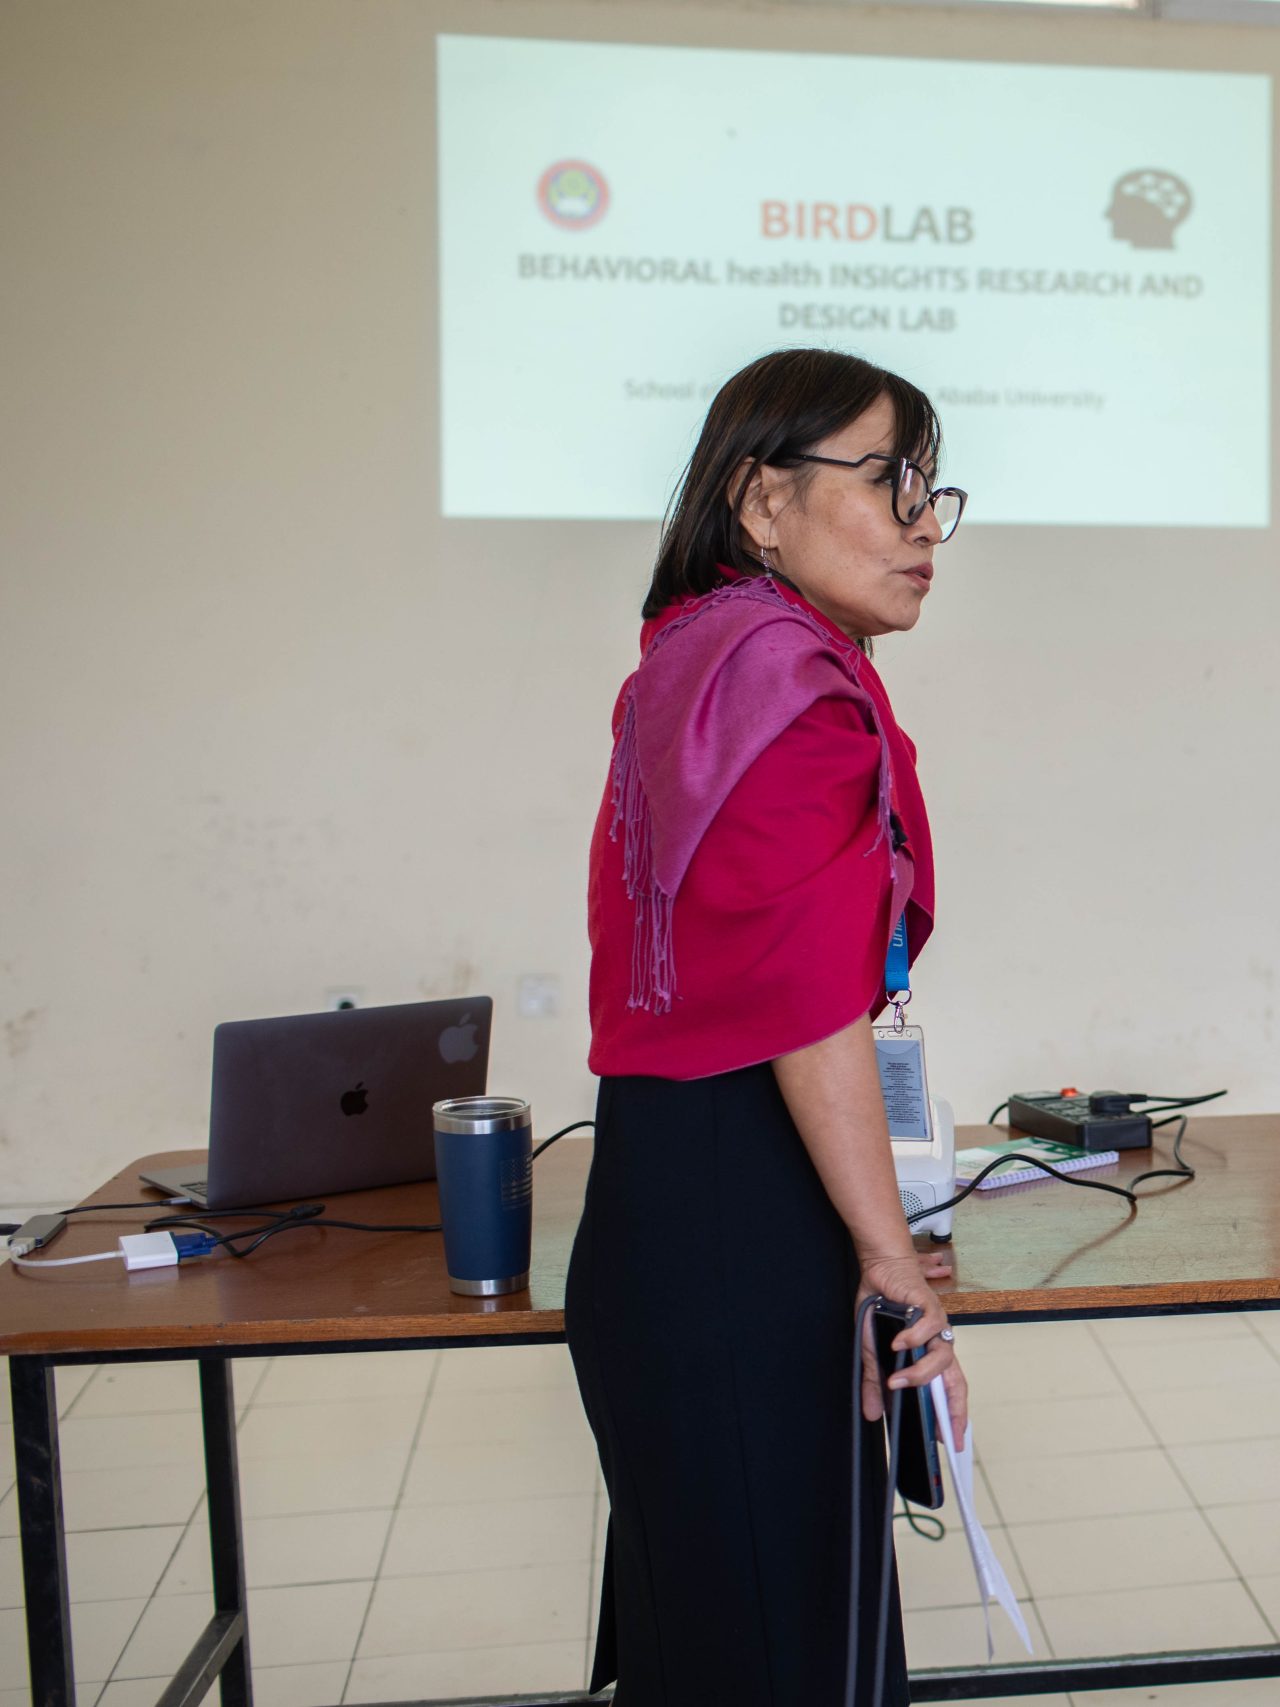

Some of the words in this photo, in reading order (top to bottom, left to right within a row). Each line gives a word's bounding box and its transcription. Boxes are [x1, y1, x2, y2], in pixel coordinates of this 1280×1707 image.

[760, 199, 974, 244] BIRDLAB
[518, 253, 717, 284] BEHAVIORAL
[726, 260, 821, 288] health
[829, 262, 968, 292] INSIGHTS
[977, 267, 1131, 296] RESEARCH
[1138, 272, 1203, 299] AND
[779, 302, 890, 331] DESIGN
[899, 306, 956, 332] LAB
[624, 377, 695, 401] School
[1004, 387, 1106, 413] University
